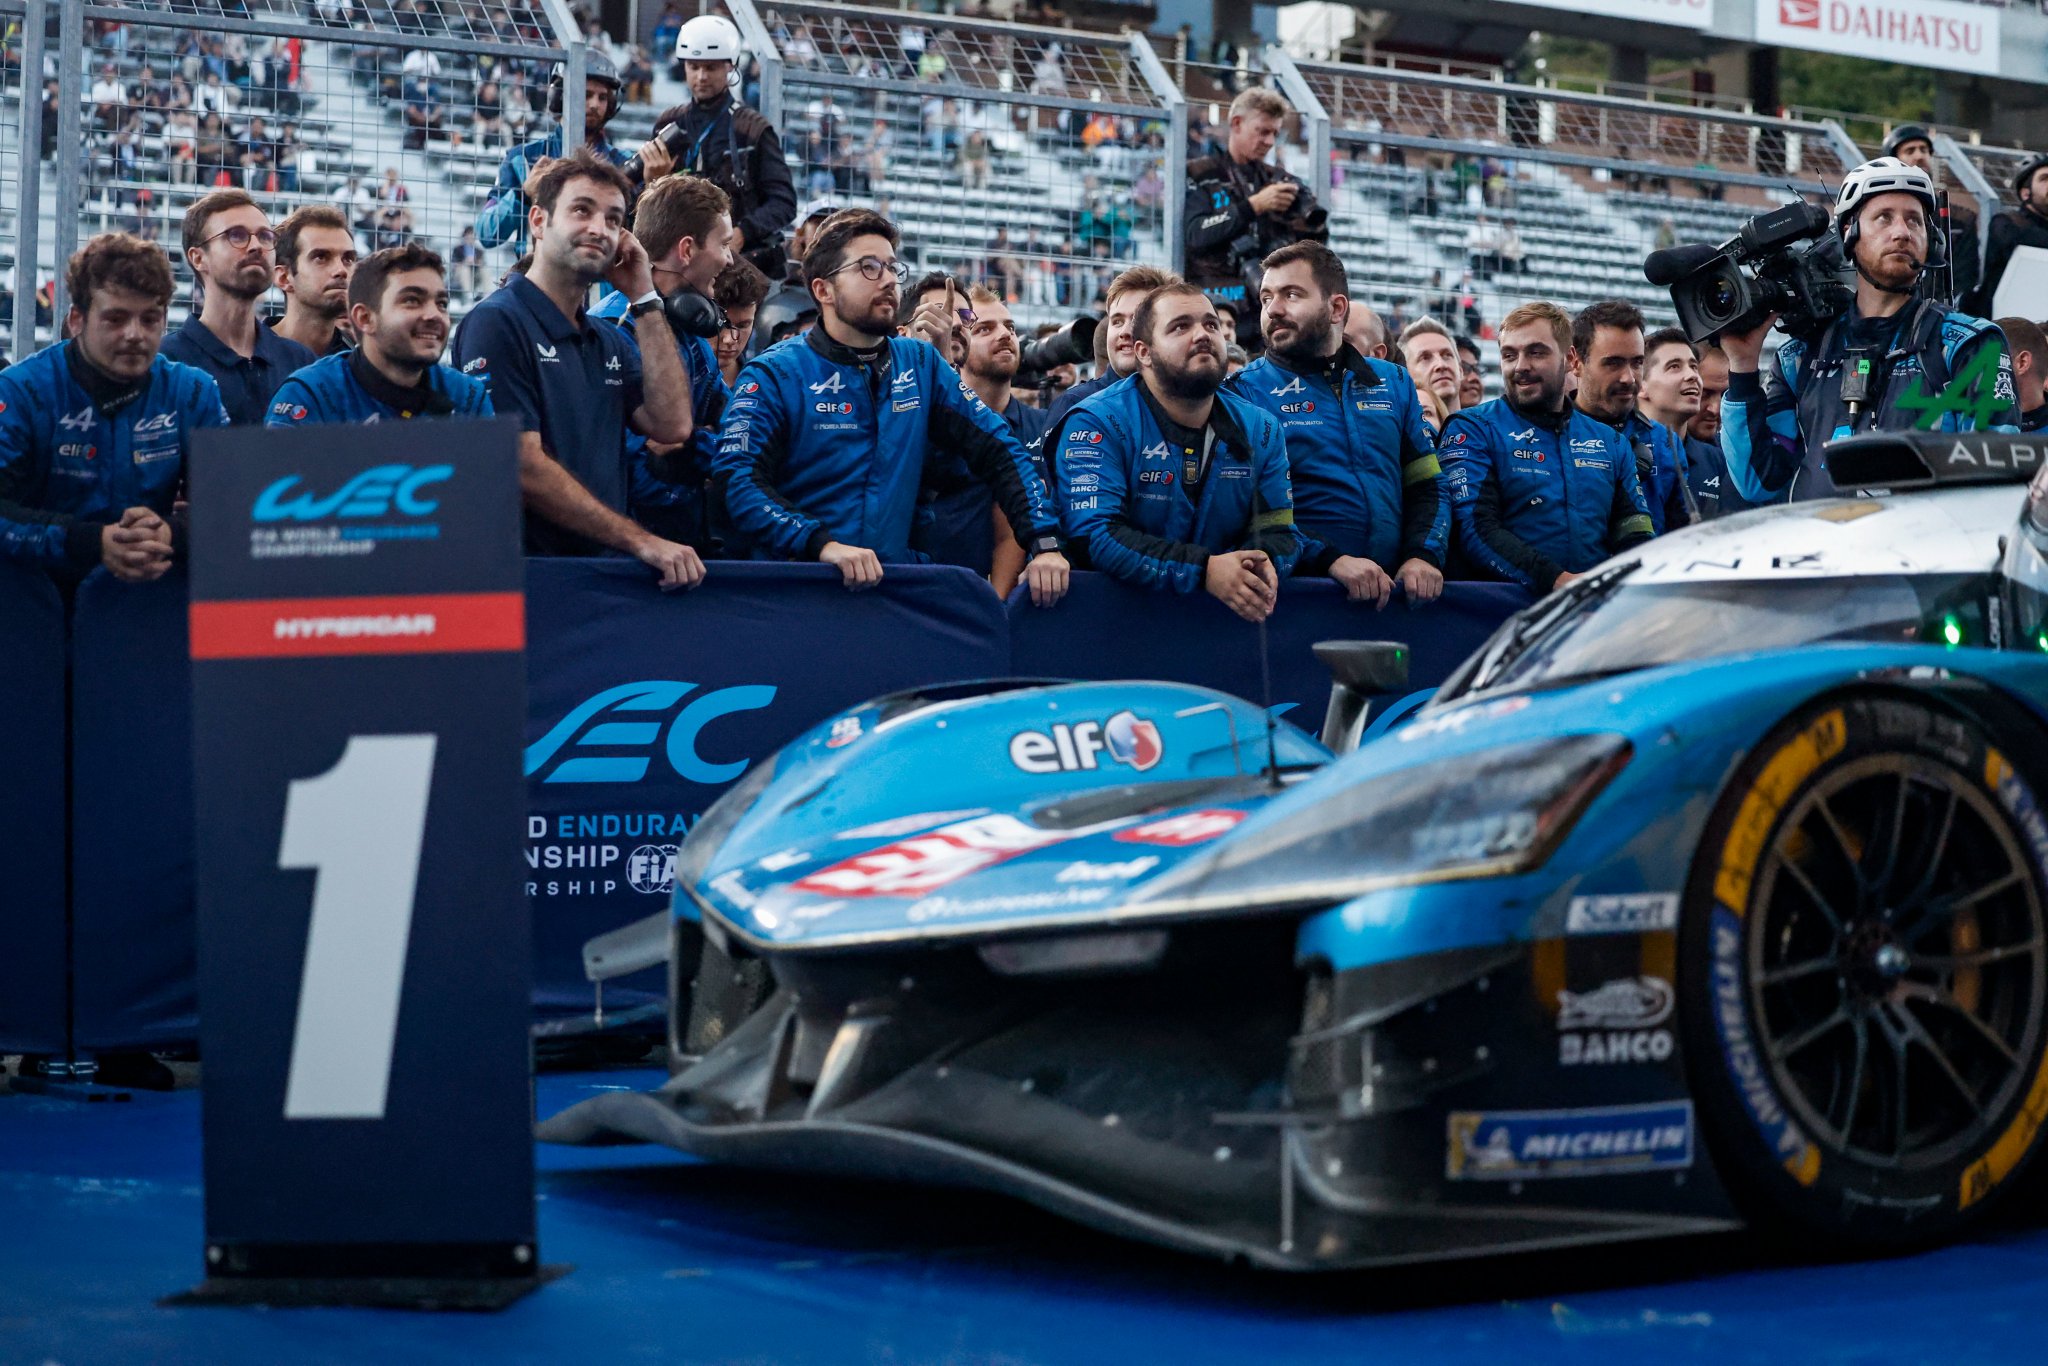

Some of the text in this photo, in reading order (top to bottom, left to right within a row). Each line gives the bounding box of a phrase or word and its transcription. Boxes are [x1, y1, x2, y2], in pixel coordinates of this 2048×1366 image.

[1829, 8, 1983, 56] DAIHATSU
[273, 402, 293, 414] elf
[815, 402, 838, 413] elf
[1280, 404, 1301, 413] elf
[1069, 431, 1089, 441] elf
[1570, 438, 1605, 448] WEC
[59, 444, 81, 456] elf
[1513, 449, 1533, 459] elf
[1140, 471, 1161, 482] elf
[252, 464, 455, 522] WEC
[1070, 485, 1098, 493] BAHCO
[1070, 496, 1098, 511] ixell
[274, 614, 436, 639] HYPERCAR
[1010, 721, 1103, 773] elf
[278, 733, 438, 1119] 1
[1559, 1030, 1674, 1065] BAHCO
[1522, 1125, 1686, 1158] MICHELIN
